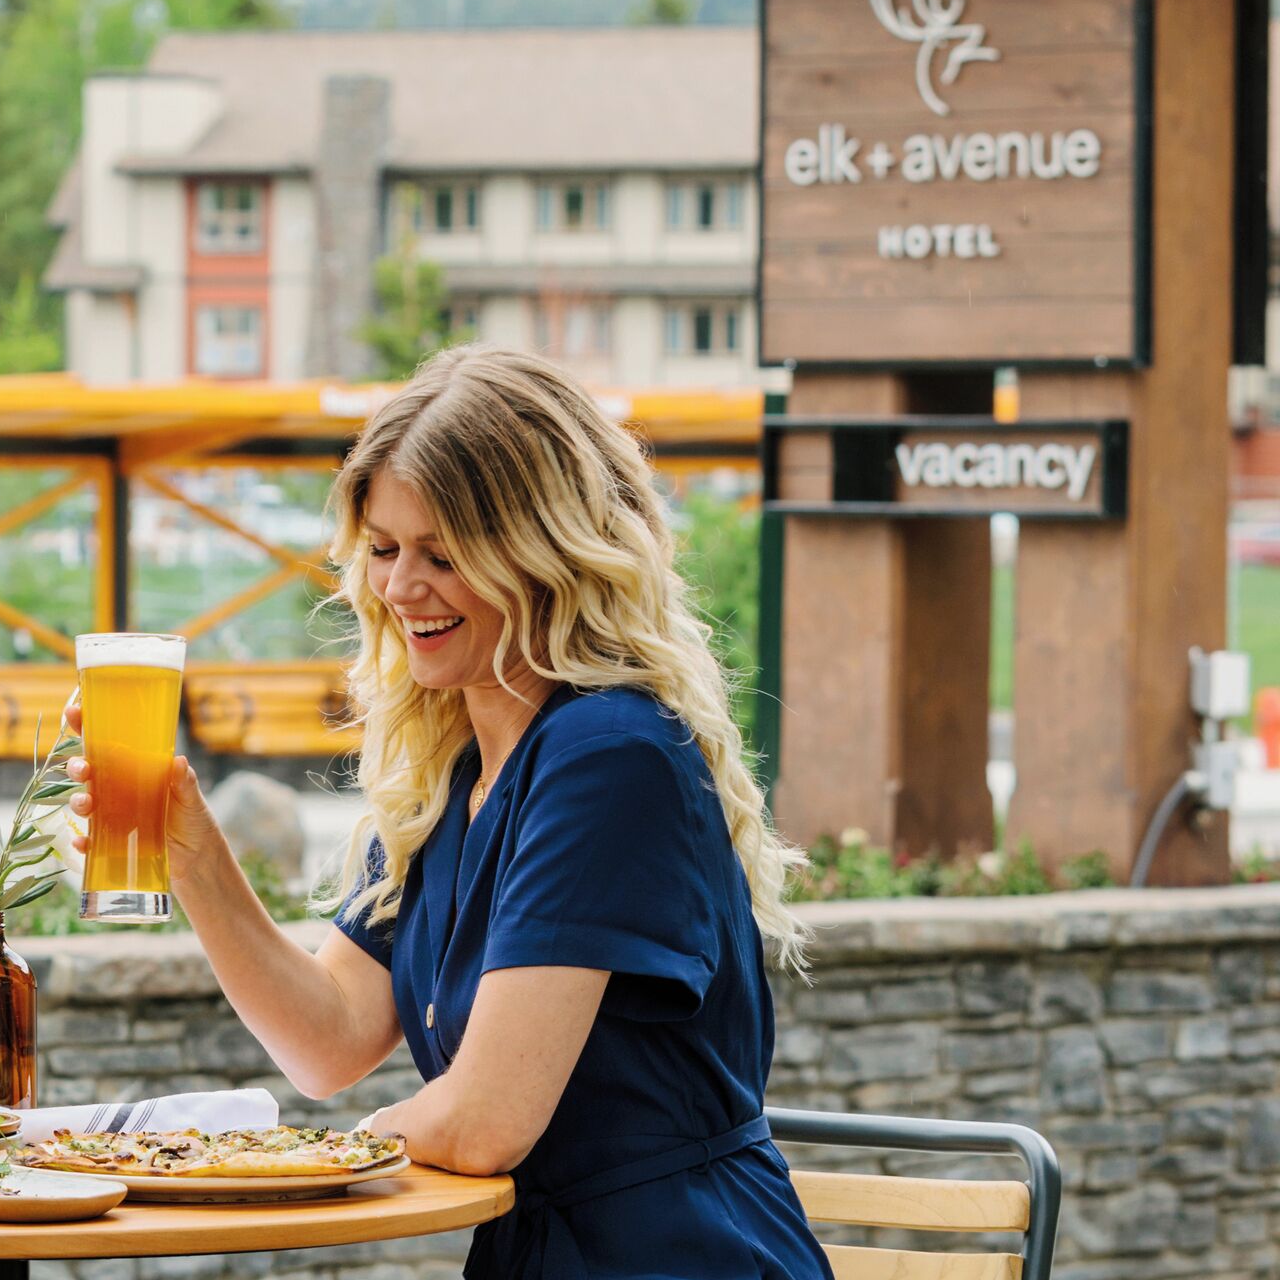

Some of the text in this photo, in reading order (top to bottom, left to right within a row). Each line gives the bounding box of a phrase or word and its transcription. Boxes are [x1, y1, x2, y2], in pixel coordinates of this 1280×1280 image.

[783, 124, 860, 185] elk
[902, 129, 1100, 182] avenue
[878, 224, 1000, 258] HOTEL
[896, 442, 1095, 500] vacancy
